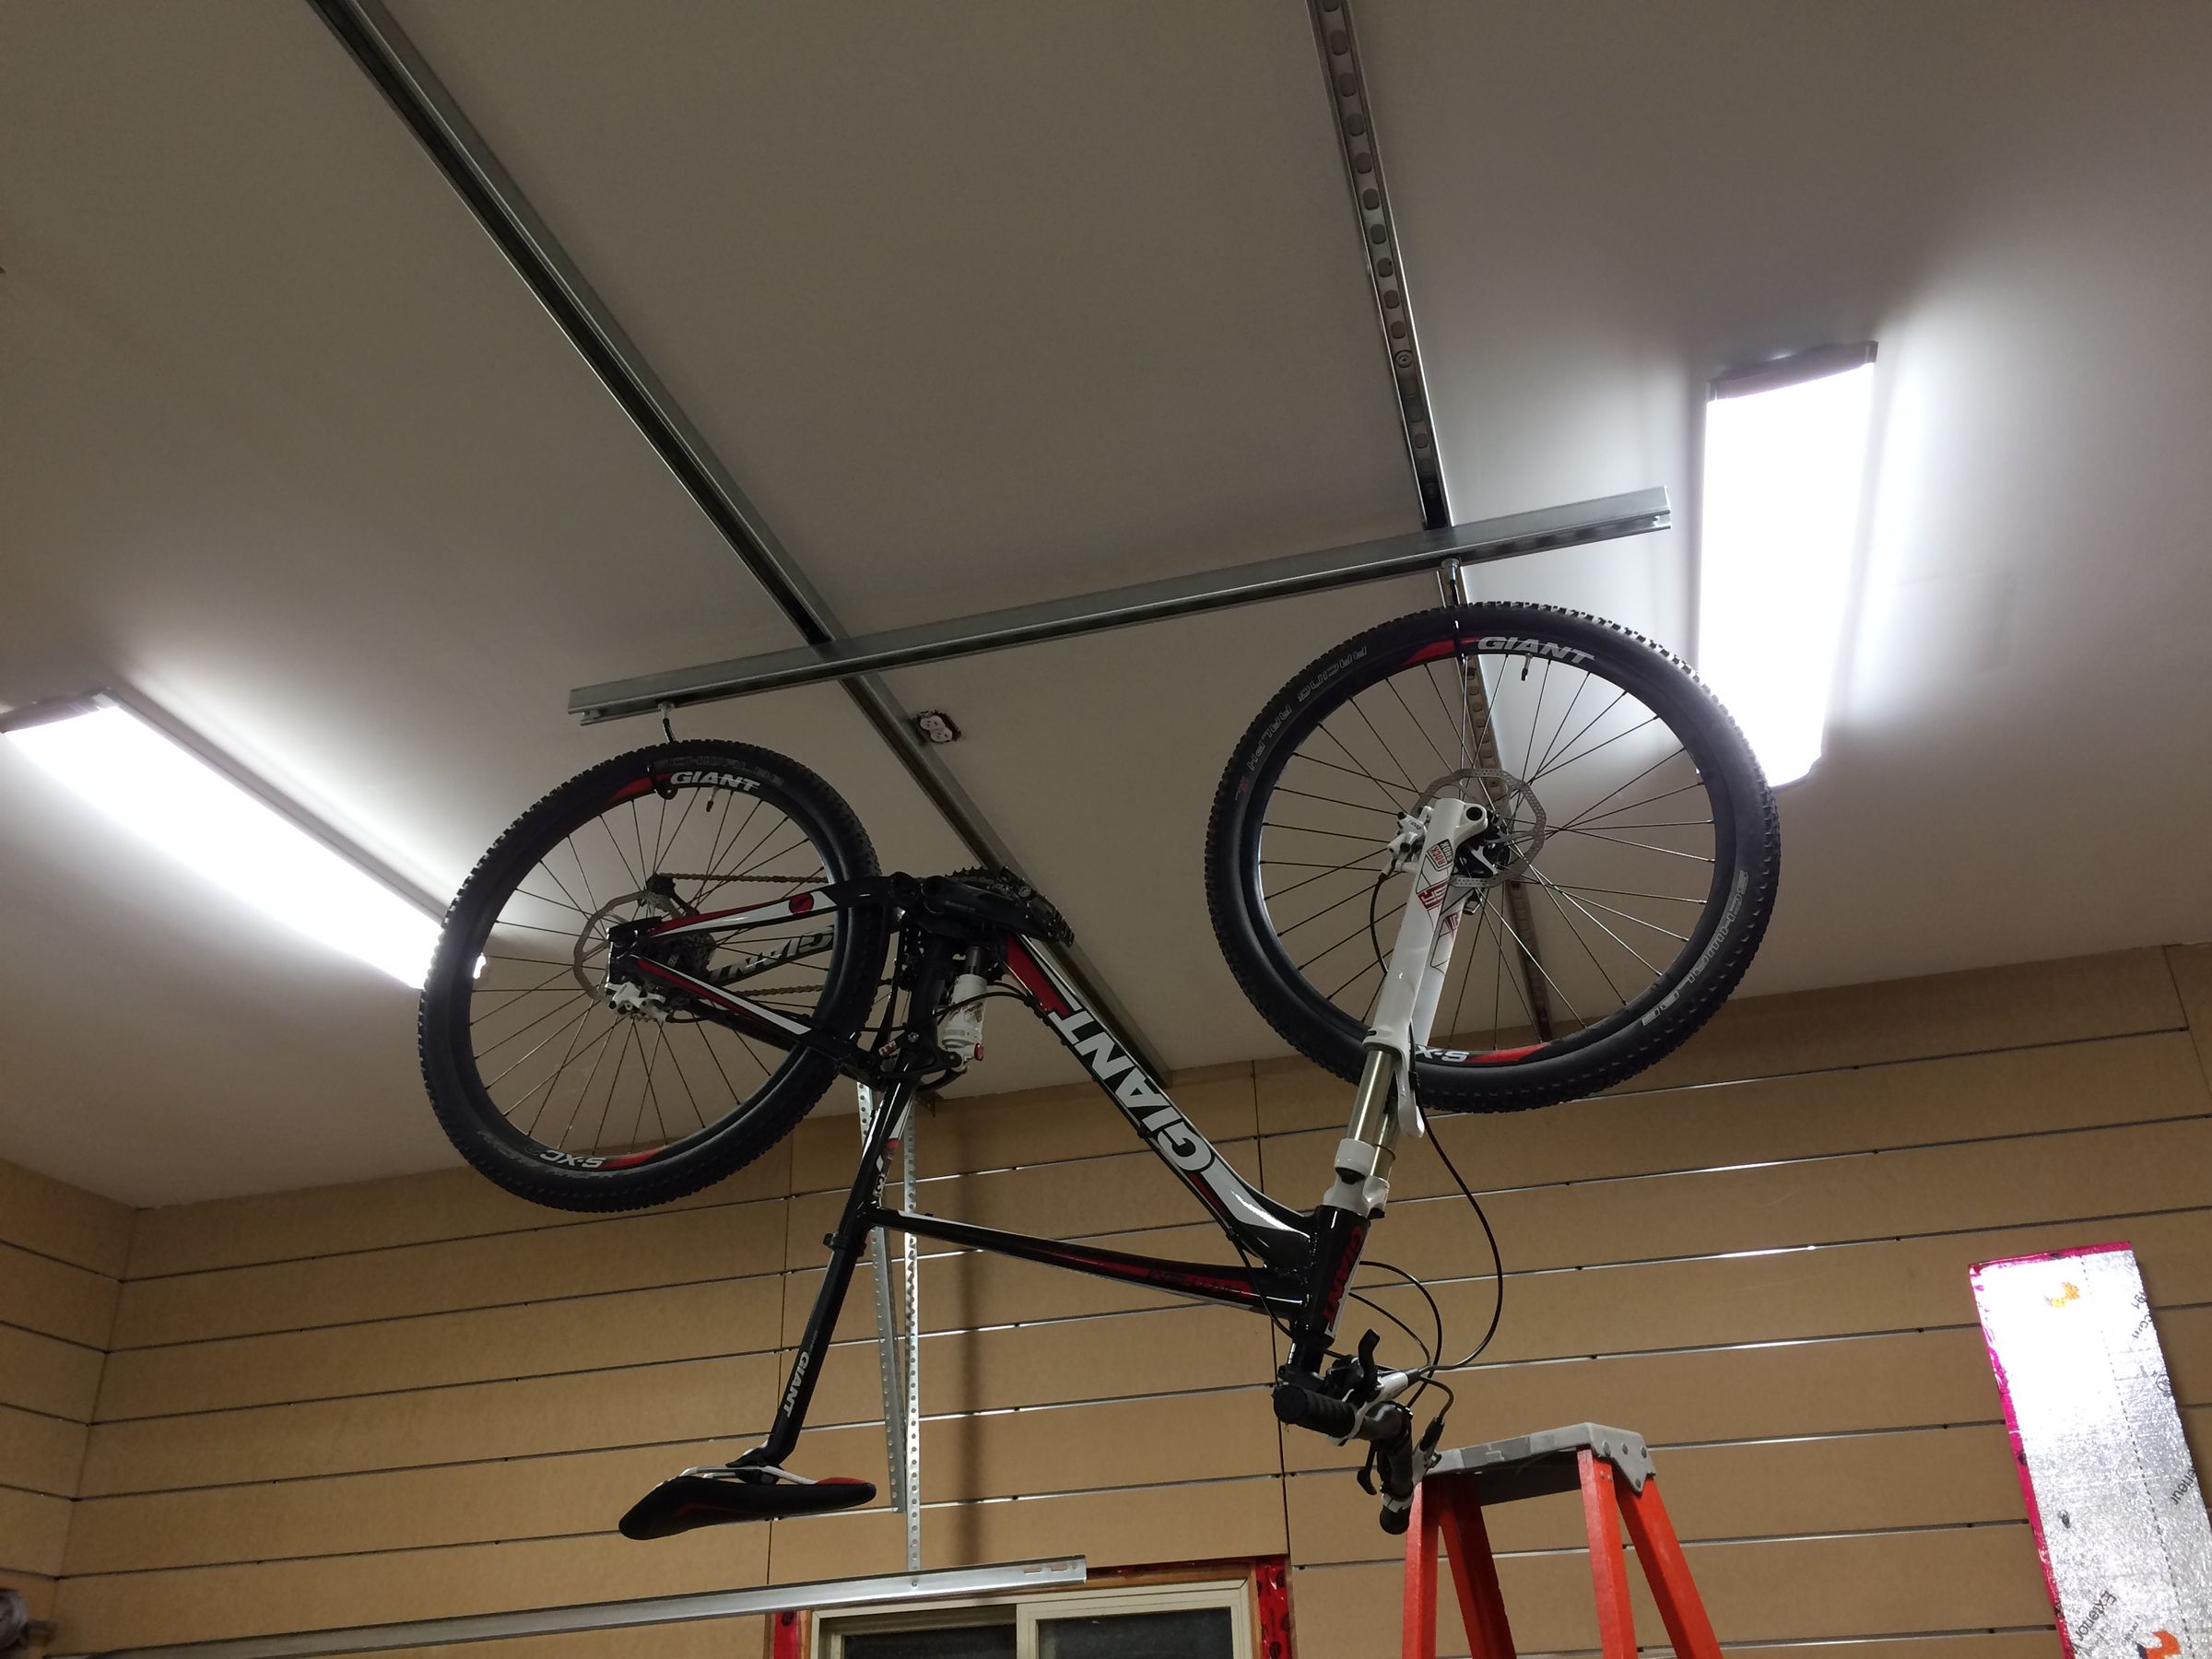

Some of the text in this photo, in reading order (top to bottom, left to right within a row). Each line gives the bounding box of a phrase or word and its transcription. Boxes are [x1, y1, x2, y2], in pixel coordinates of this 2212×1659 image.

[1477, 636, 1595, 664] GIANT
[1246, 645, 1368, 771] RACING RALPH
[670, 771, 760, 792] GIANT
[1430, 844, 1446, 867] ROCK
[1048, 1010, 1212, 1171] GIANT
[783, 1351, 810, 1418] GIANT
[2075, 1590, 2117, 1641] Exterior
